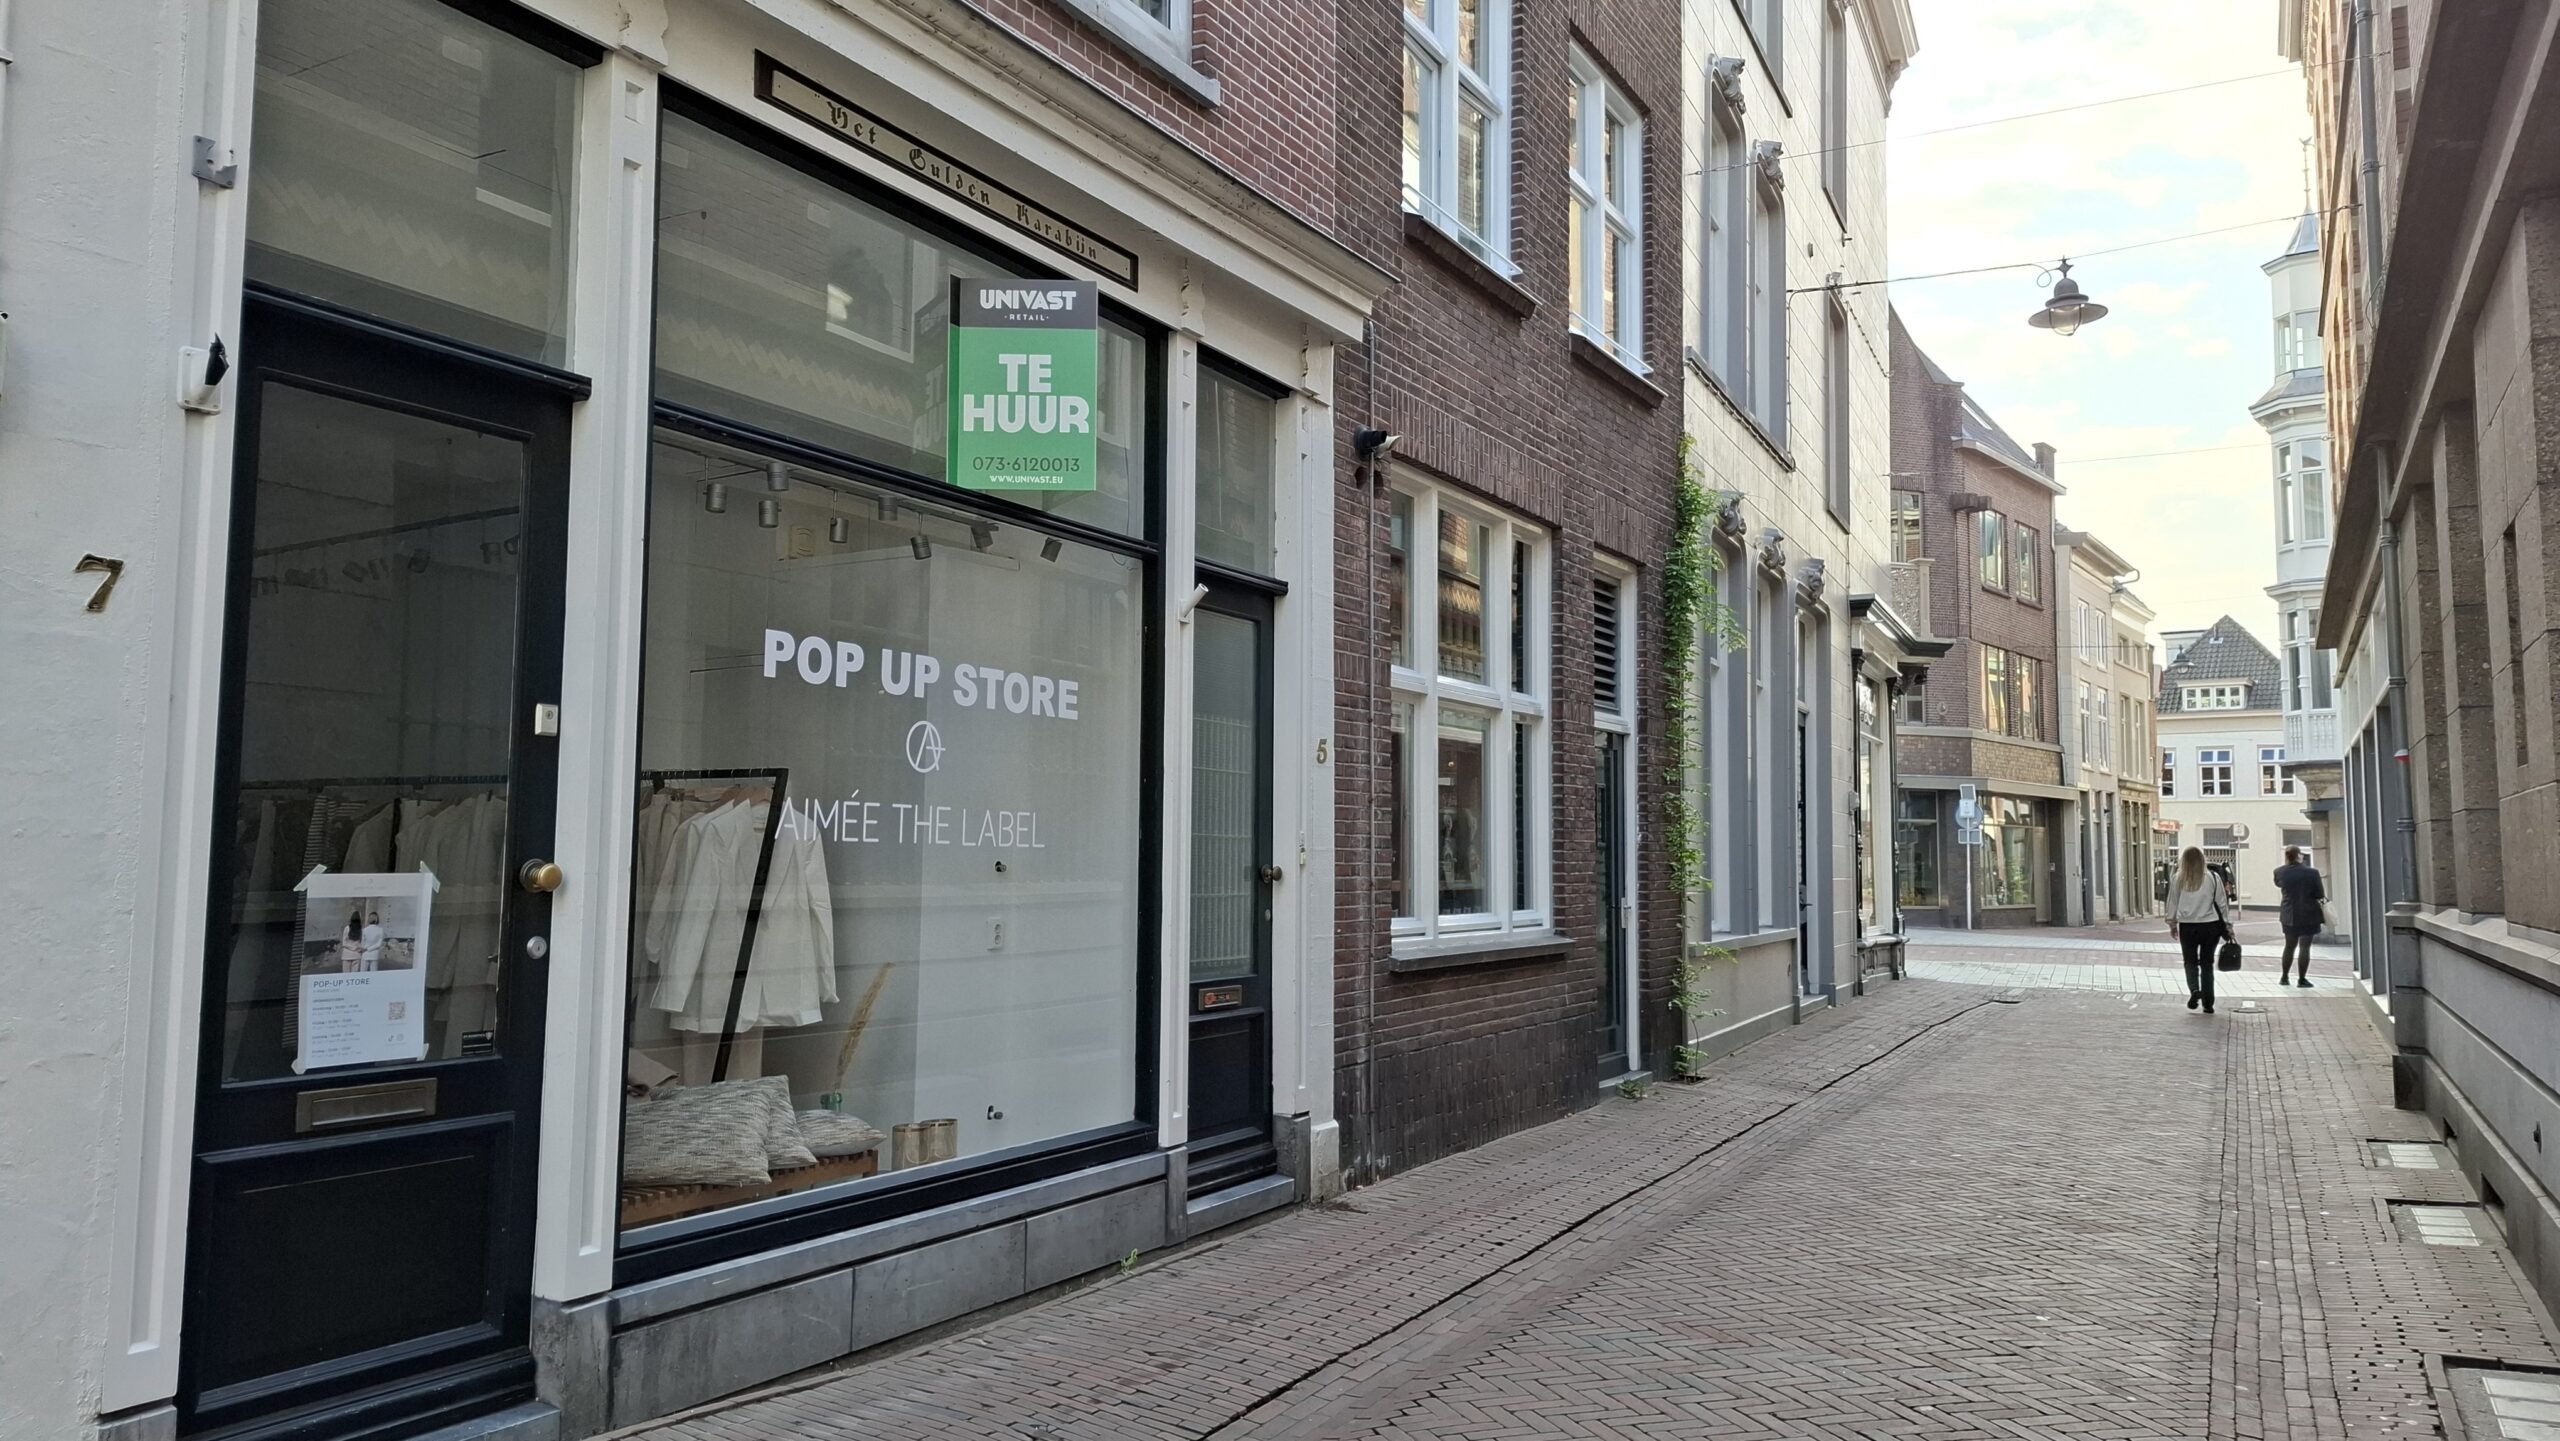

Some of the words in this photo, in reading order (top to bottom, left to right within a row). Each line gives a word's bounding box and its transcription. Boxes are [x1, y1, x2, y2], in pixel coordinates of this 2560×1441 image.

[909, 148, 990, 205] Gulden
[1016, 203, 1097, 259] Karabijn
[979, 289, 1077, 310] UNIVAST
[998, 353, 1052, 393] TE
[963, 394, 1090, 434] HUUR
[989, 475, 1063, 484] WWW.UNIVAST.EU
[74, 553, 124, 613] 7
[763, 628, 864, 688] POP
[881, 648, 940, 698] UP
[953, 663, 1079, 720] STORE
[1316, 738, 1328, 764] 5
[774, 788, 880, 843] AIMÉE
[892, 803, 951, 844] THE
[961, 808, 1045, 848] LABEL
[313, 979, 344, 988] POP-UP
[345, 977, 371, 986] STORE
